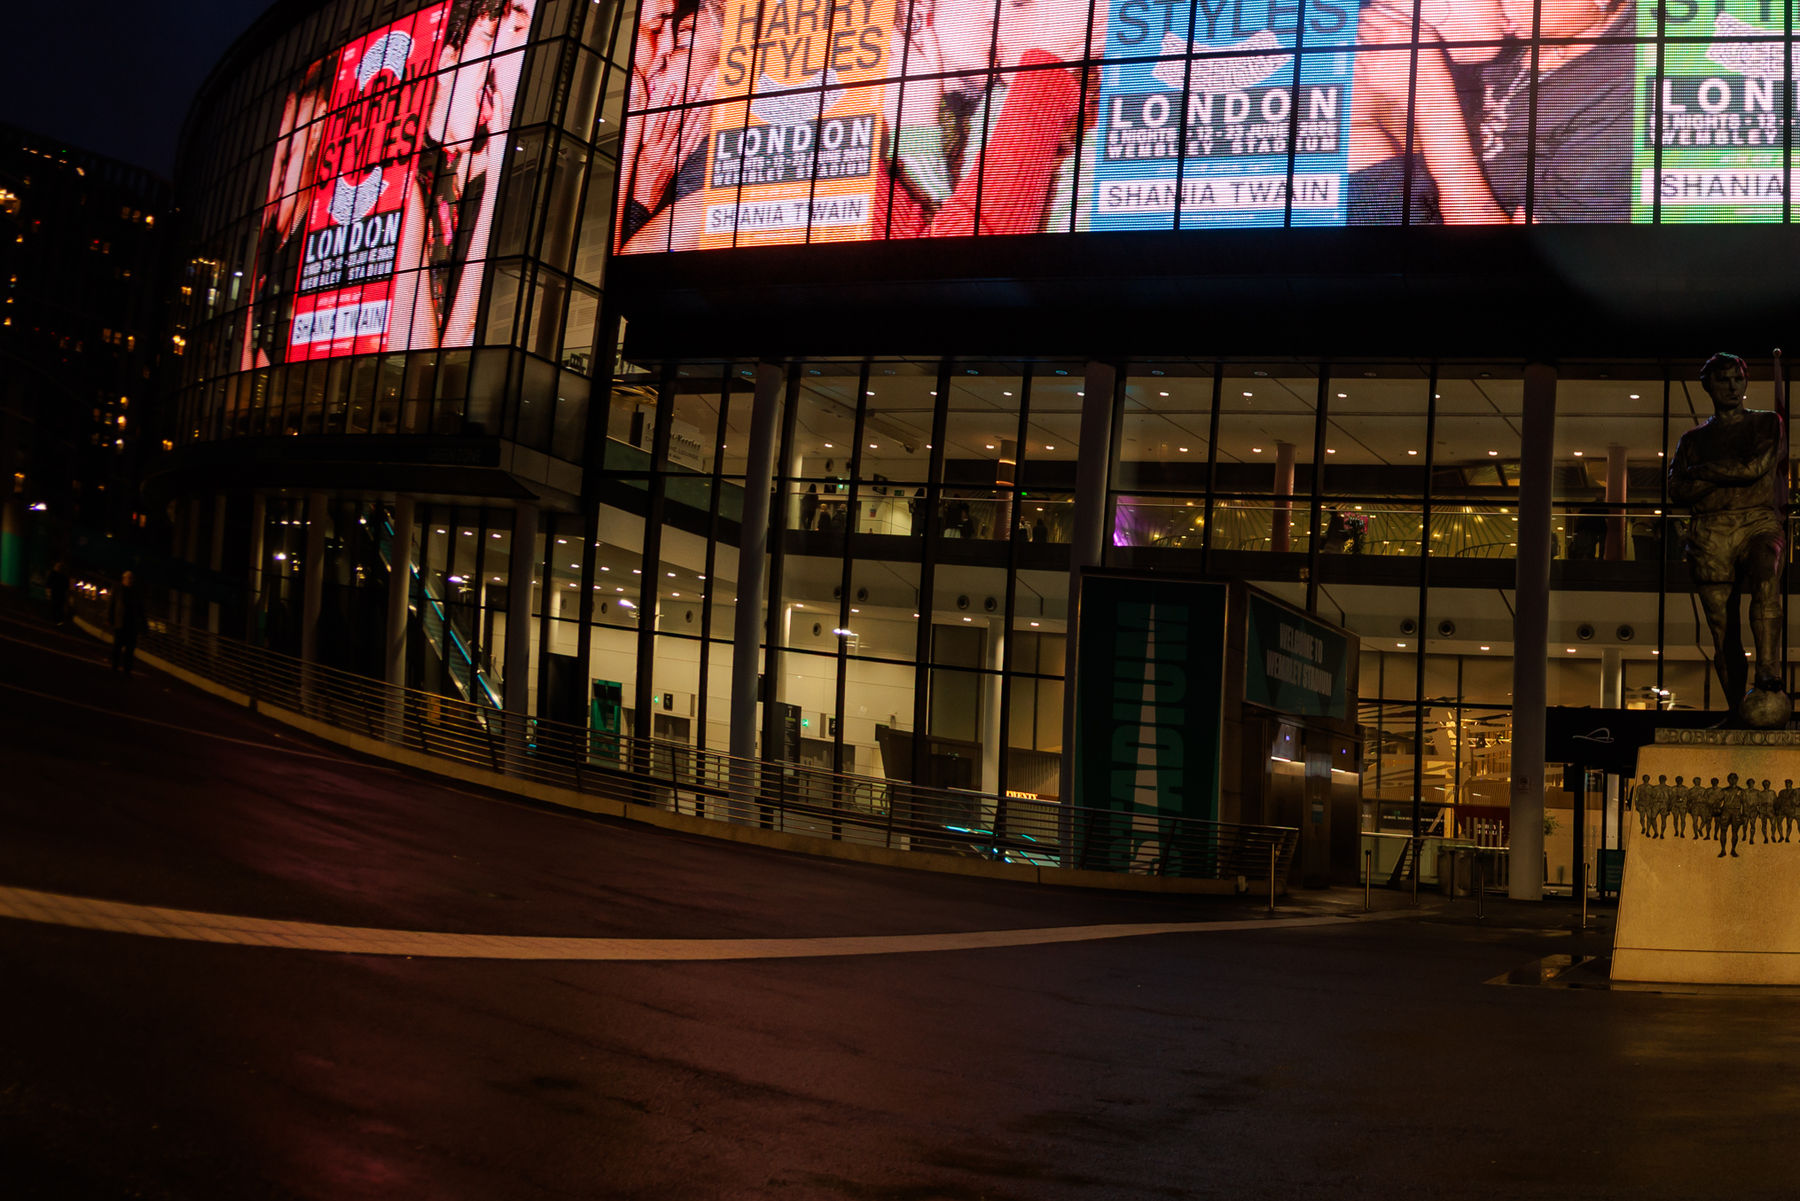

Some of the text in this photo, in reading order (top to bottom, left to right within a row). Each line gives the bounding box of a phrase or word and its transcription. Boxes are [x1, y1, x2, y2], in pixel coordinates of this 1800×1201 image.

[724, 27, 883, 86] STYLES
[331, 59, 428, 138] HARRY
[1112, 88, 1337, 128] LONDON
[1121, 128, 1179, 143] NIGHTS
[1247, 122, 1290, 138] JUNE
[1673, 114, 1740, 129] NIGHTS
[717, 117, 872, 159] LONDON
[1108, 138, 1337, 158] WEMBLEY STADIUM
[1652, 129, 1777, 145] WEMBLEY
[320, 113, 419, 189] STYLES
[714, 162, 870, 186] WEMBLEY STADIUM
[1661, 174, 1784, 197] SHANIA
[1108, 180, 1329, 207] SHANIA TWAIN
[711, 199, 861, 228] SHANIA TWAIN
[306, 212, 400, 262] LONDON
[1313, 636, 1324, 664] TO
[1666, 728, 1729, 745] BOBBY
